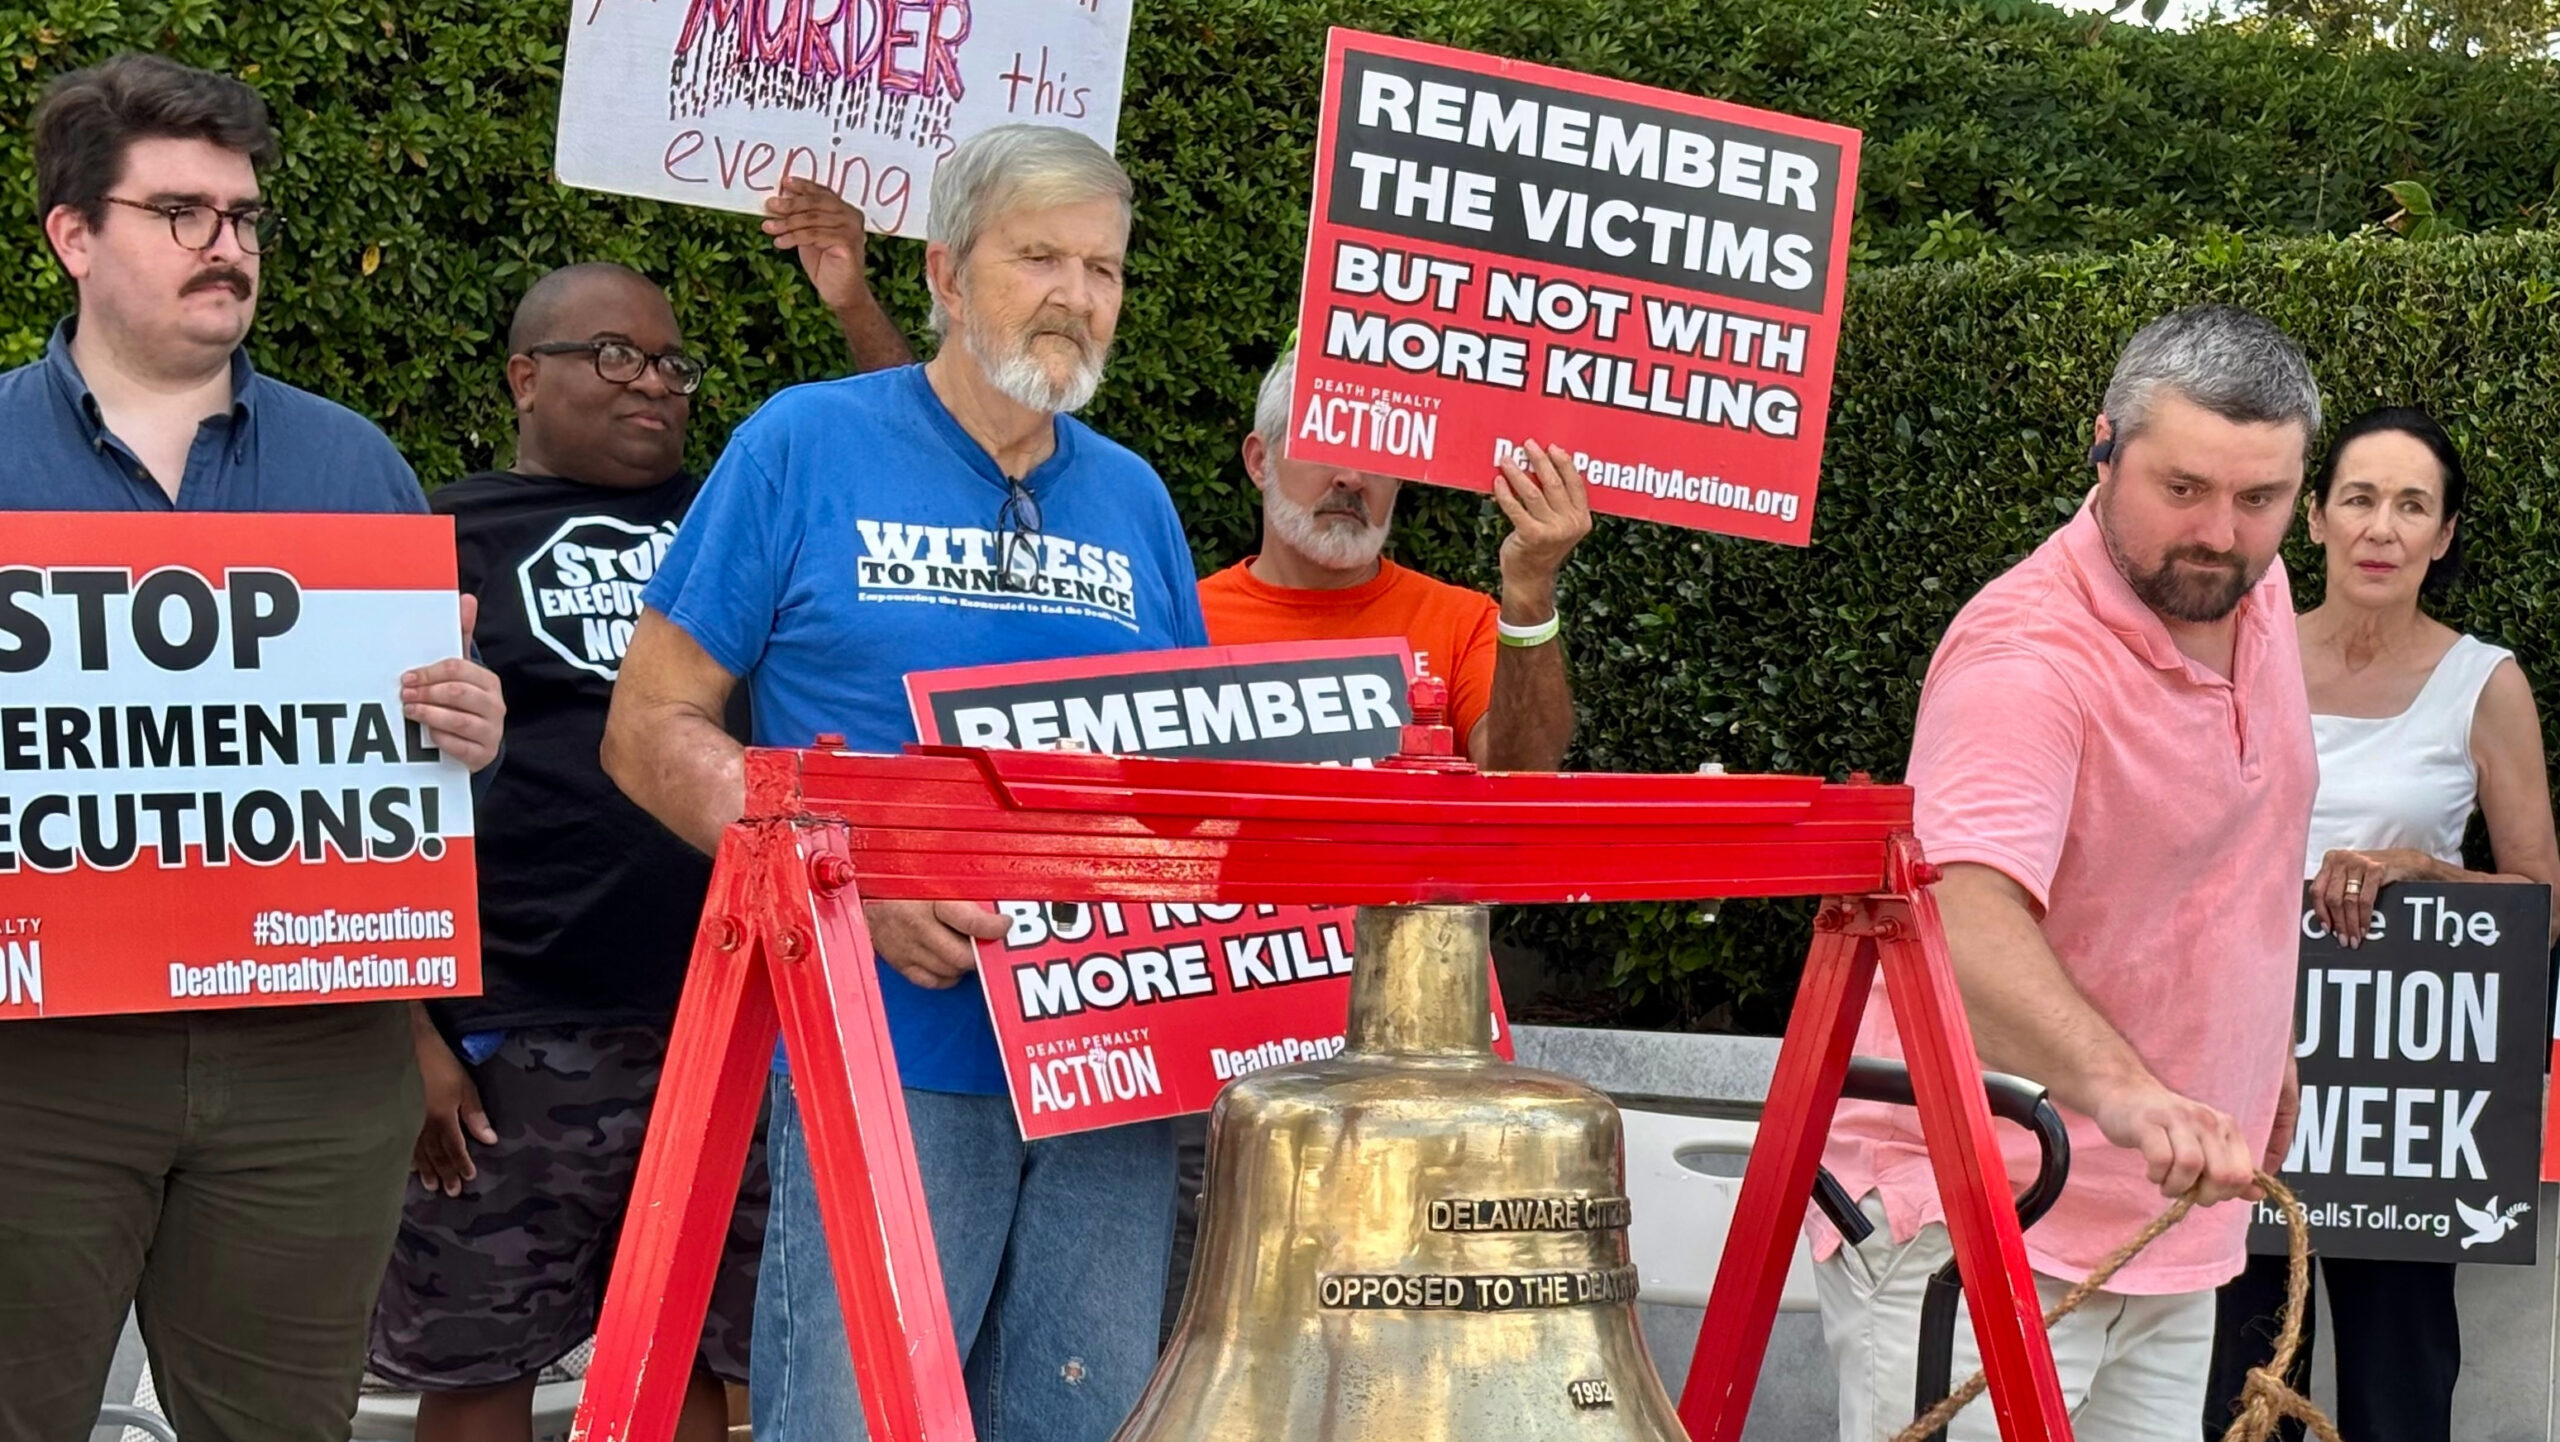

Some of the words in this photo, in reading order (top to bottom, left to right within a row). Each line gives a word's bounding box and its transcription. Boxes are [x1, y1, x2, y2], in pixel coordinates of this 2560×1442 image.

[999, 46, 1091, 118] this
[1358, 70, 1819, 211] REMEMBER
[1351, 151, 1496, 232] THE
[1519, 183, 1814, 291] VICTIMS
[1335, 245, 1469, 308] BUT
[1488, 273, 1628, 338] NOT
[1646, 301, 1806, 373] WITH
[1314, 378, 1365, 397] DEATH
[1371, 388, 1441, 410] PENALTY
[1327, 312, 1526, 387] MORE
[1546, 349, 1798, 436] KILLING
[1299, 394, 1437, 460] ACTION
[1494, 438, 1799, 522] DePenaltyAction.org
[856, 520, 1133, 590] WITNESS
[862, 561, 915, 585] TO
[0, 569, 300, 673] STOP
[582, 618, 638, 661] NO
[954, 674, 1401, 754] REMEMBER
[254, 908, 453, 946] #StopExecutions
[1225, 927, 1353, 988] KILL
[170, 956, 456, 997] DeathPenaltyAction.org
[1016, 945, 1213, 1018] MORE
[1026, 1039, 1075, 1057] DEATH
[1082, 1027, 1149, 1048] PENALTY
[1028, 1045, 1162, 1115] ACTION
[2281, 1085, 2491, 1180] WEEK
[1432, 1199, 1579, 1230] DELAWARE
[1321, 1275, 1464, 1306] OPPOSED
[1475, 1278, 1513, 1306] TO
[1520, 1276, 1570, 1305] THE
[1572, 1381, 1614, 1405] 1992
